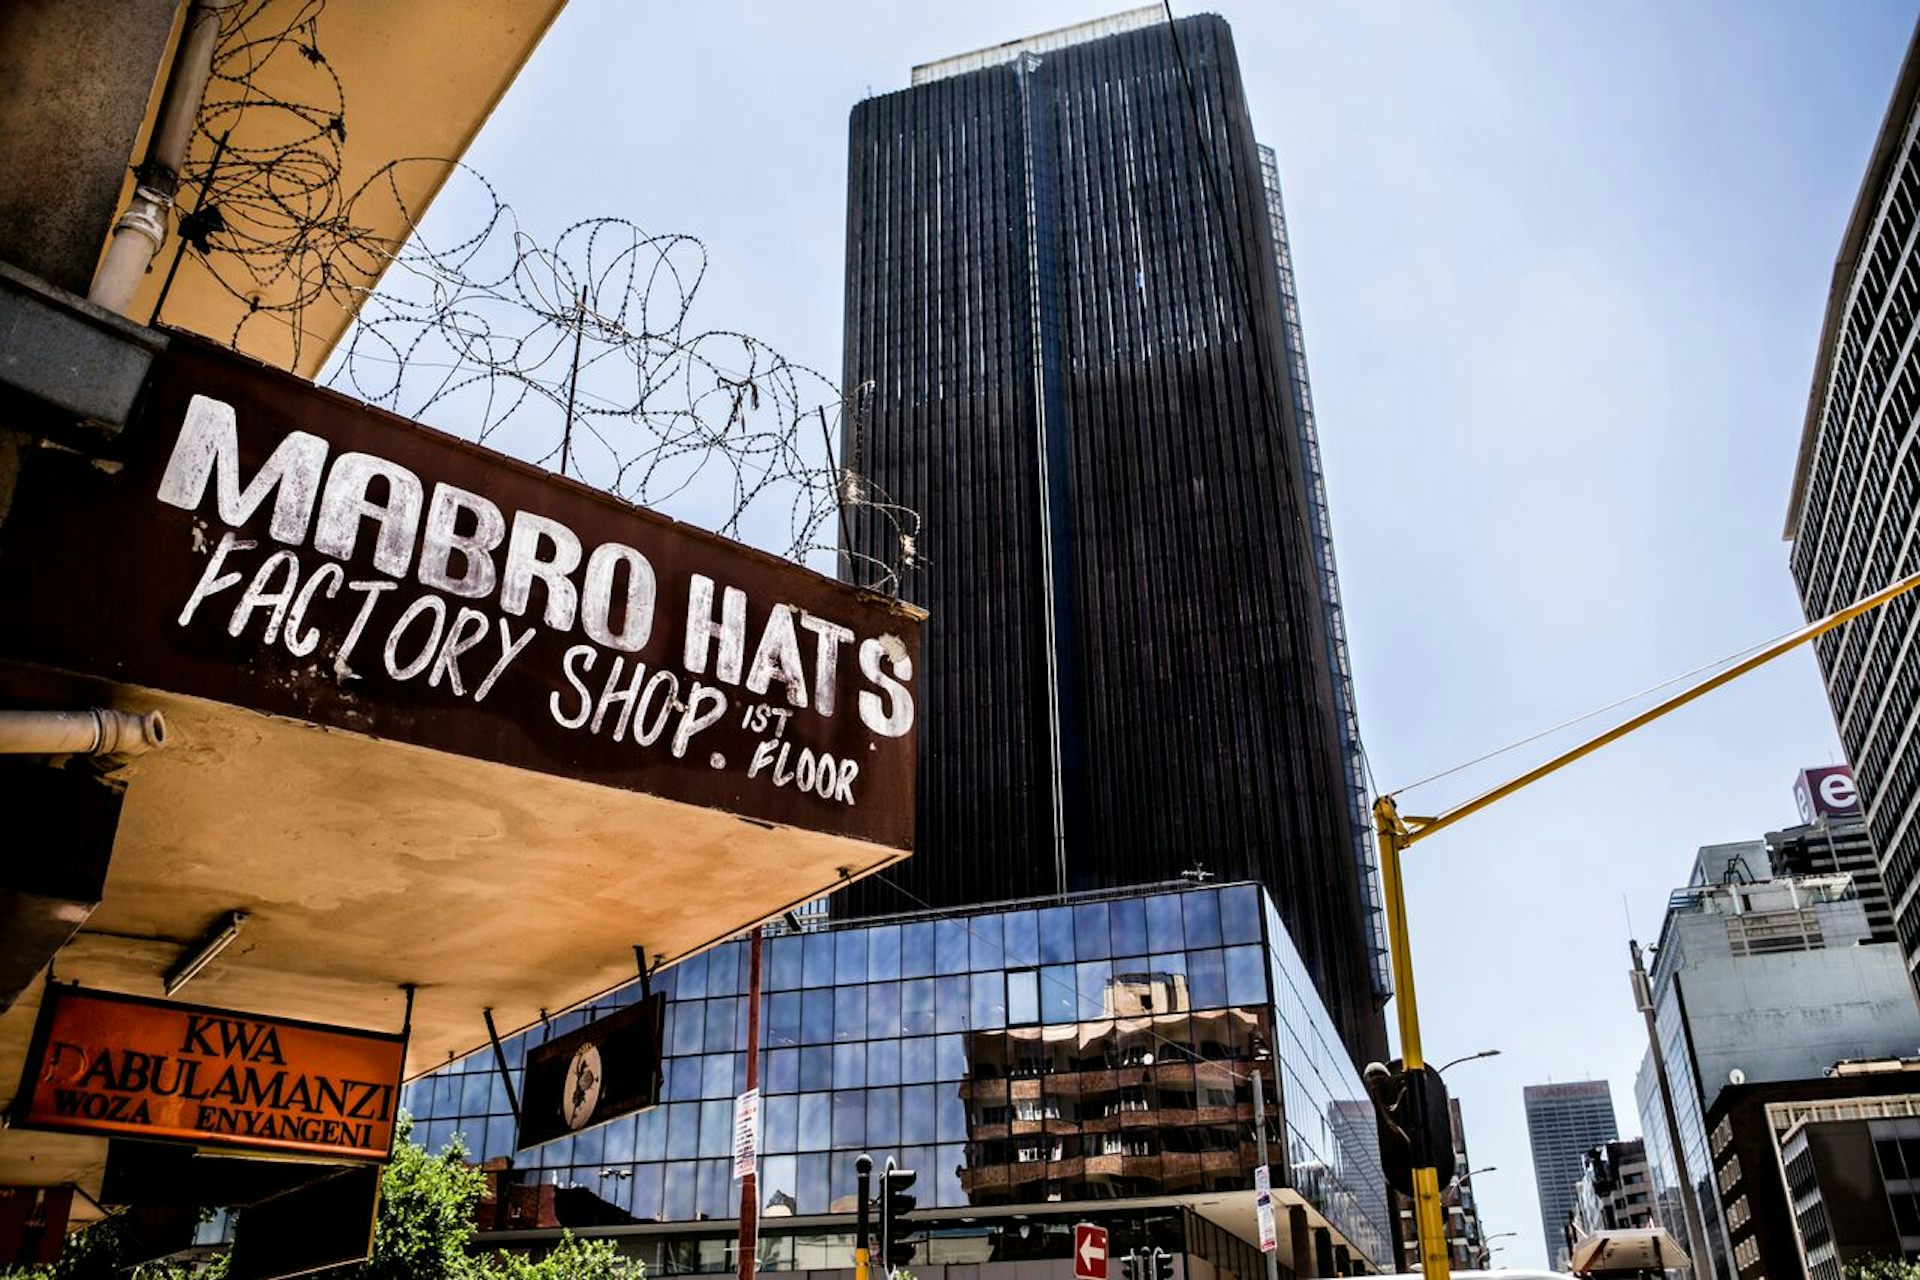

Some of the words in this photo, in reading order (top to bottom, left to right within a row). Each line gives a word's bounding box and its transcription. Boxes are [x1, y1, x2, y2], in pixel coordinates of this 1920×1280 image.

[156, 393, 657, 653] MABRO
[683, 574, 916, 738] HATS
[177, 531, 537, 703] FACTORY
[747, 738, 859, 806] FLOOR
[180, 1015, 287, 1066] KWA
[53, 1089, 153, 1125] WOZA
[194, 1106, 374, 1148] ENYANGENI
